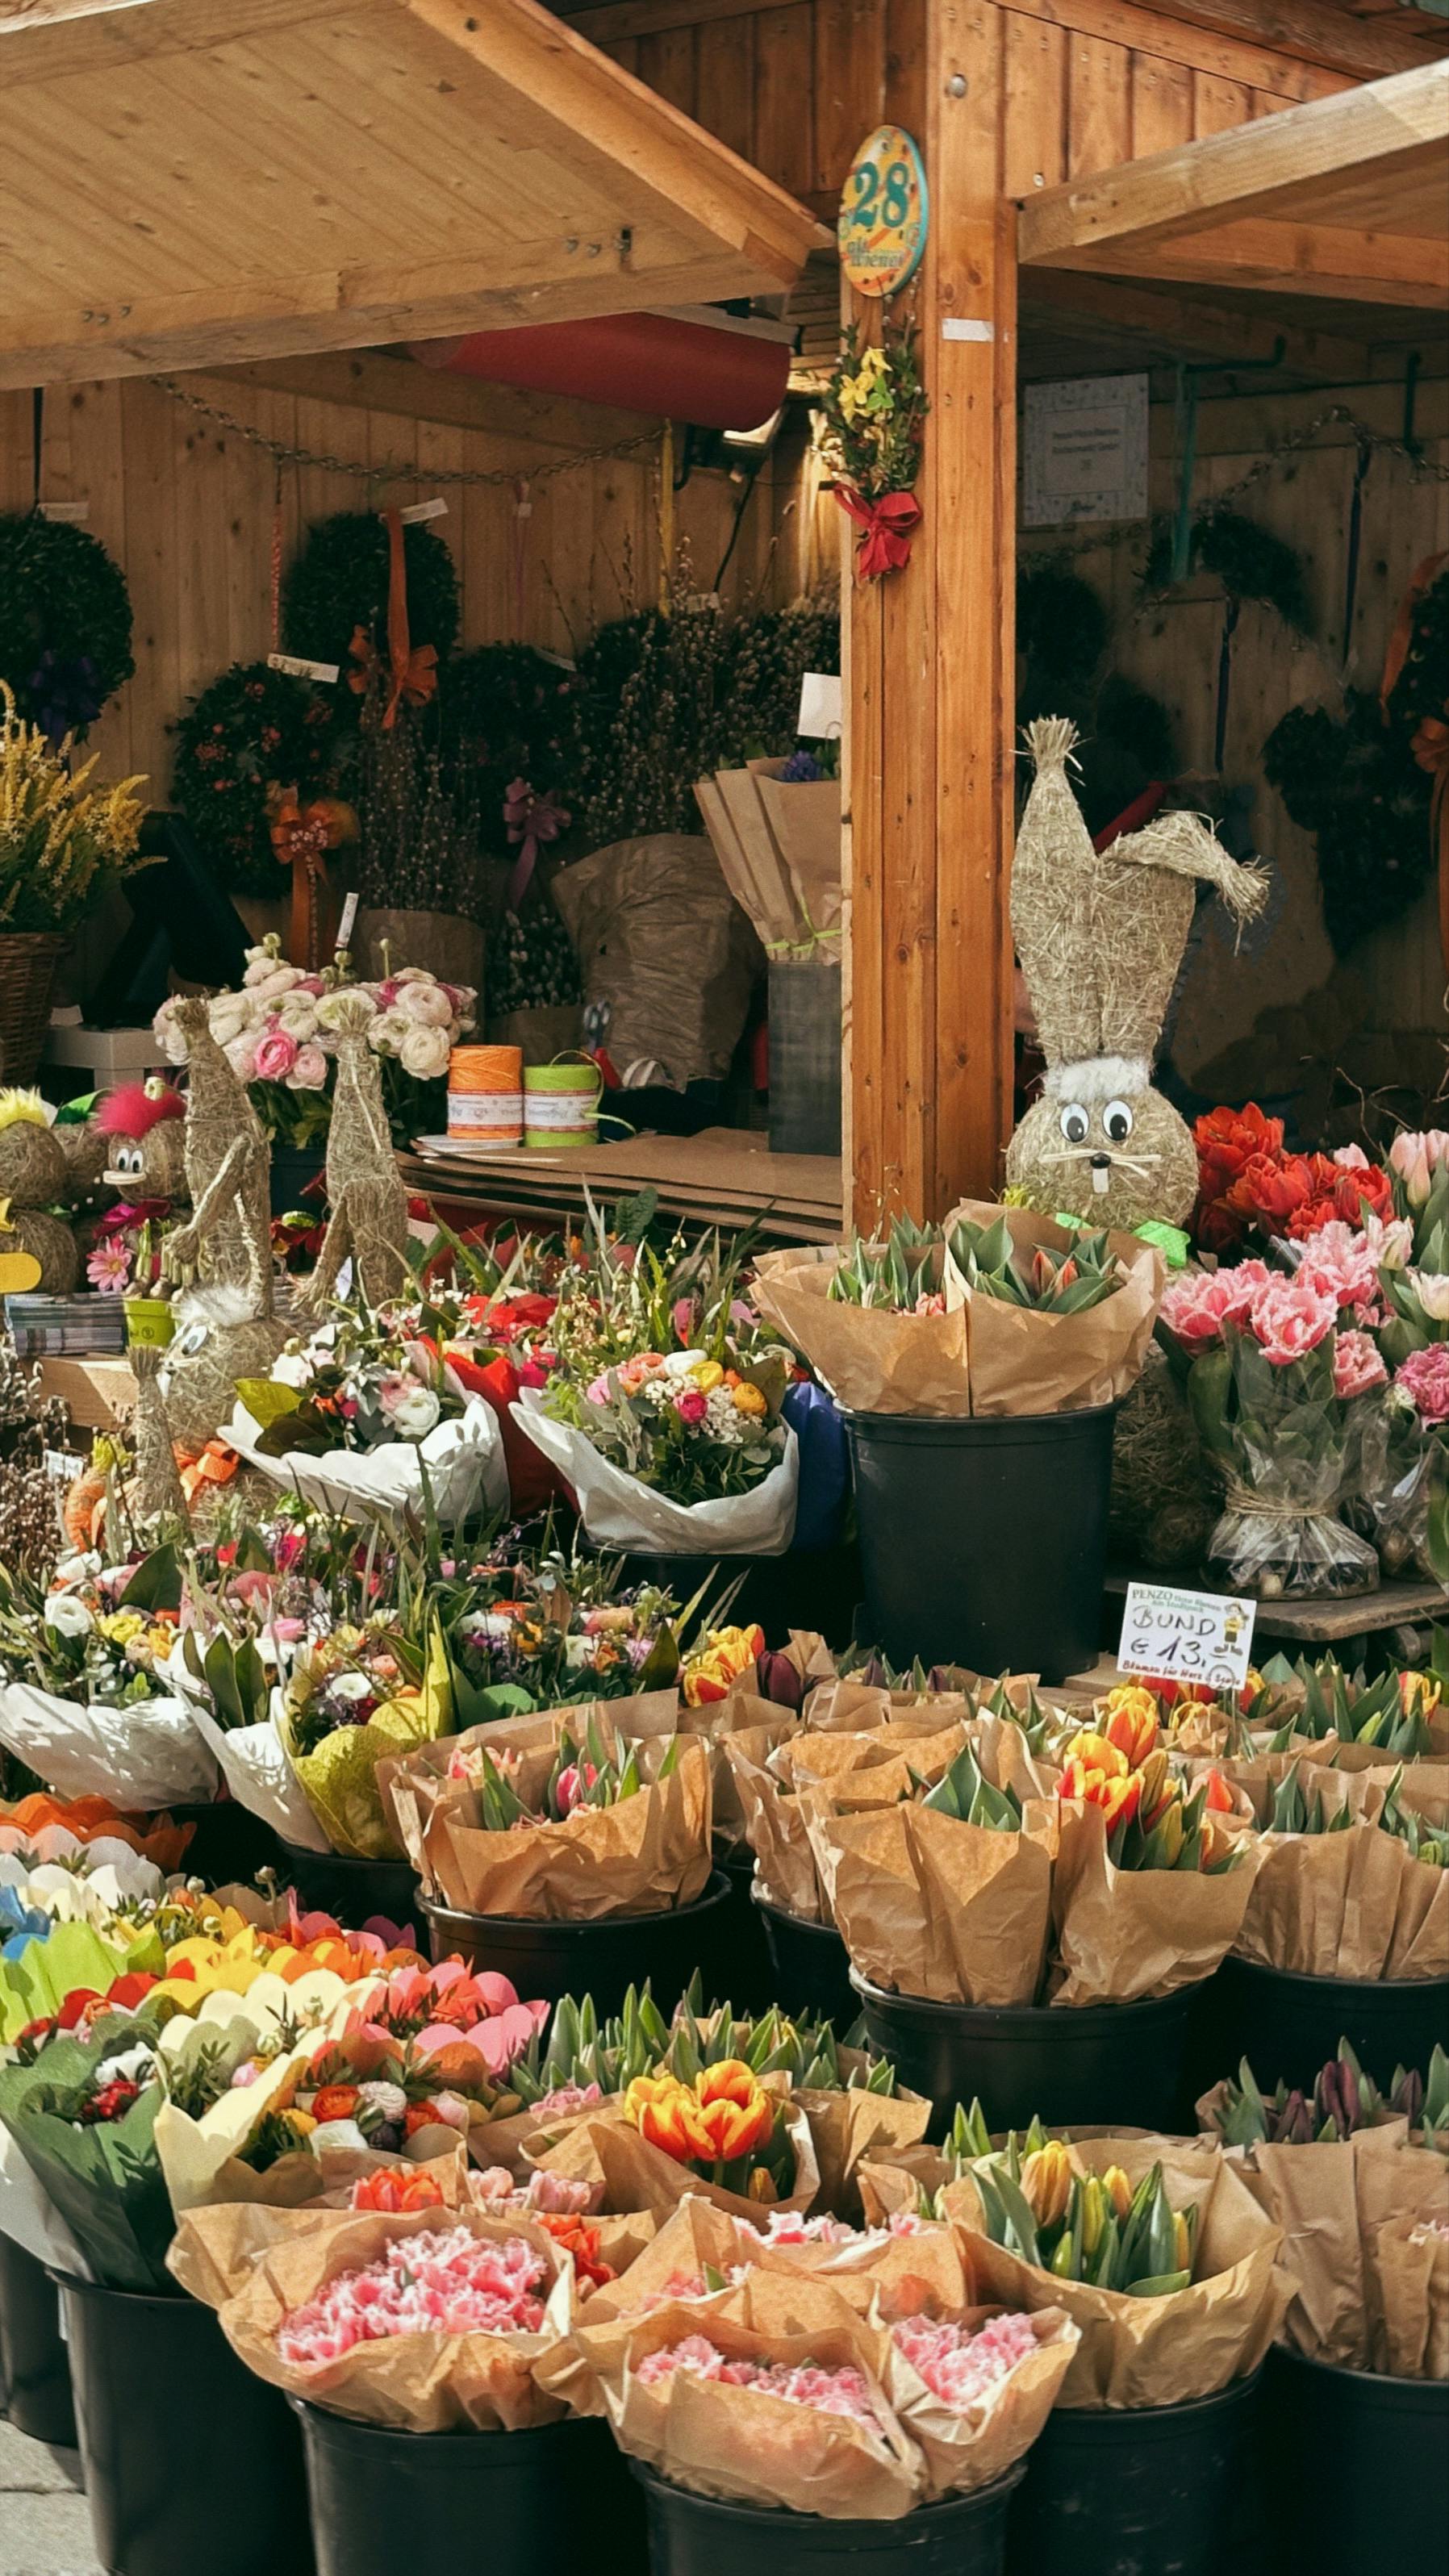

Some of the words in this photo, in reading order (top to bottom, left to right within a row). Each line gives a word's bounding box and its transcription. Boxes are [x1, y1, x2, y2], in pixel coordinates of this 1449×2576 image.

[854, 162, 909, 228] 28
[1132, 1589, 1173, 1601] PENZO
[1133, 1605, 1216, 1636] BUND
